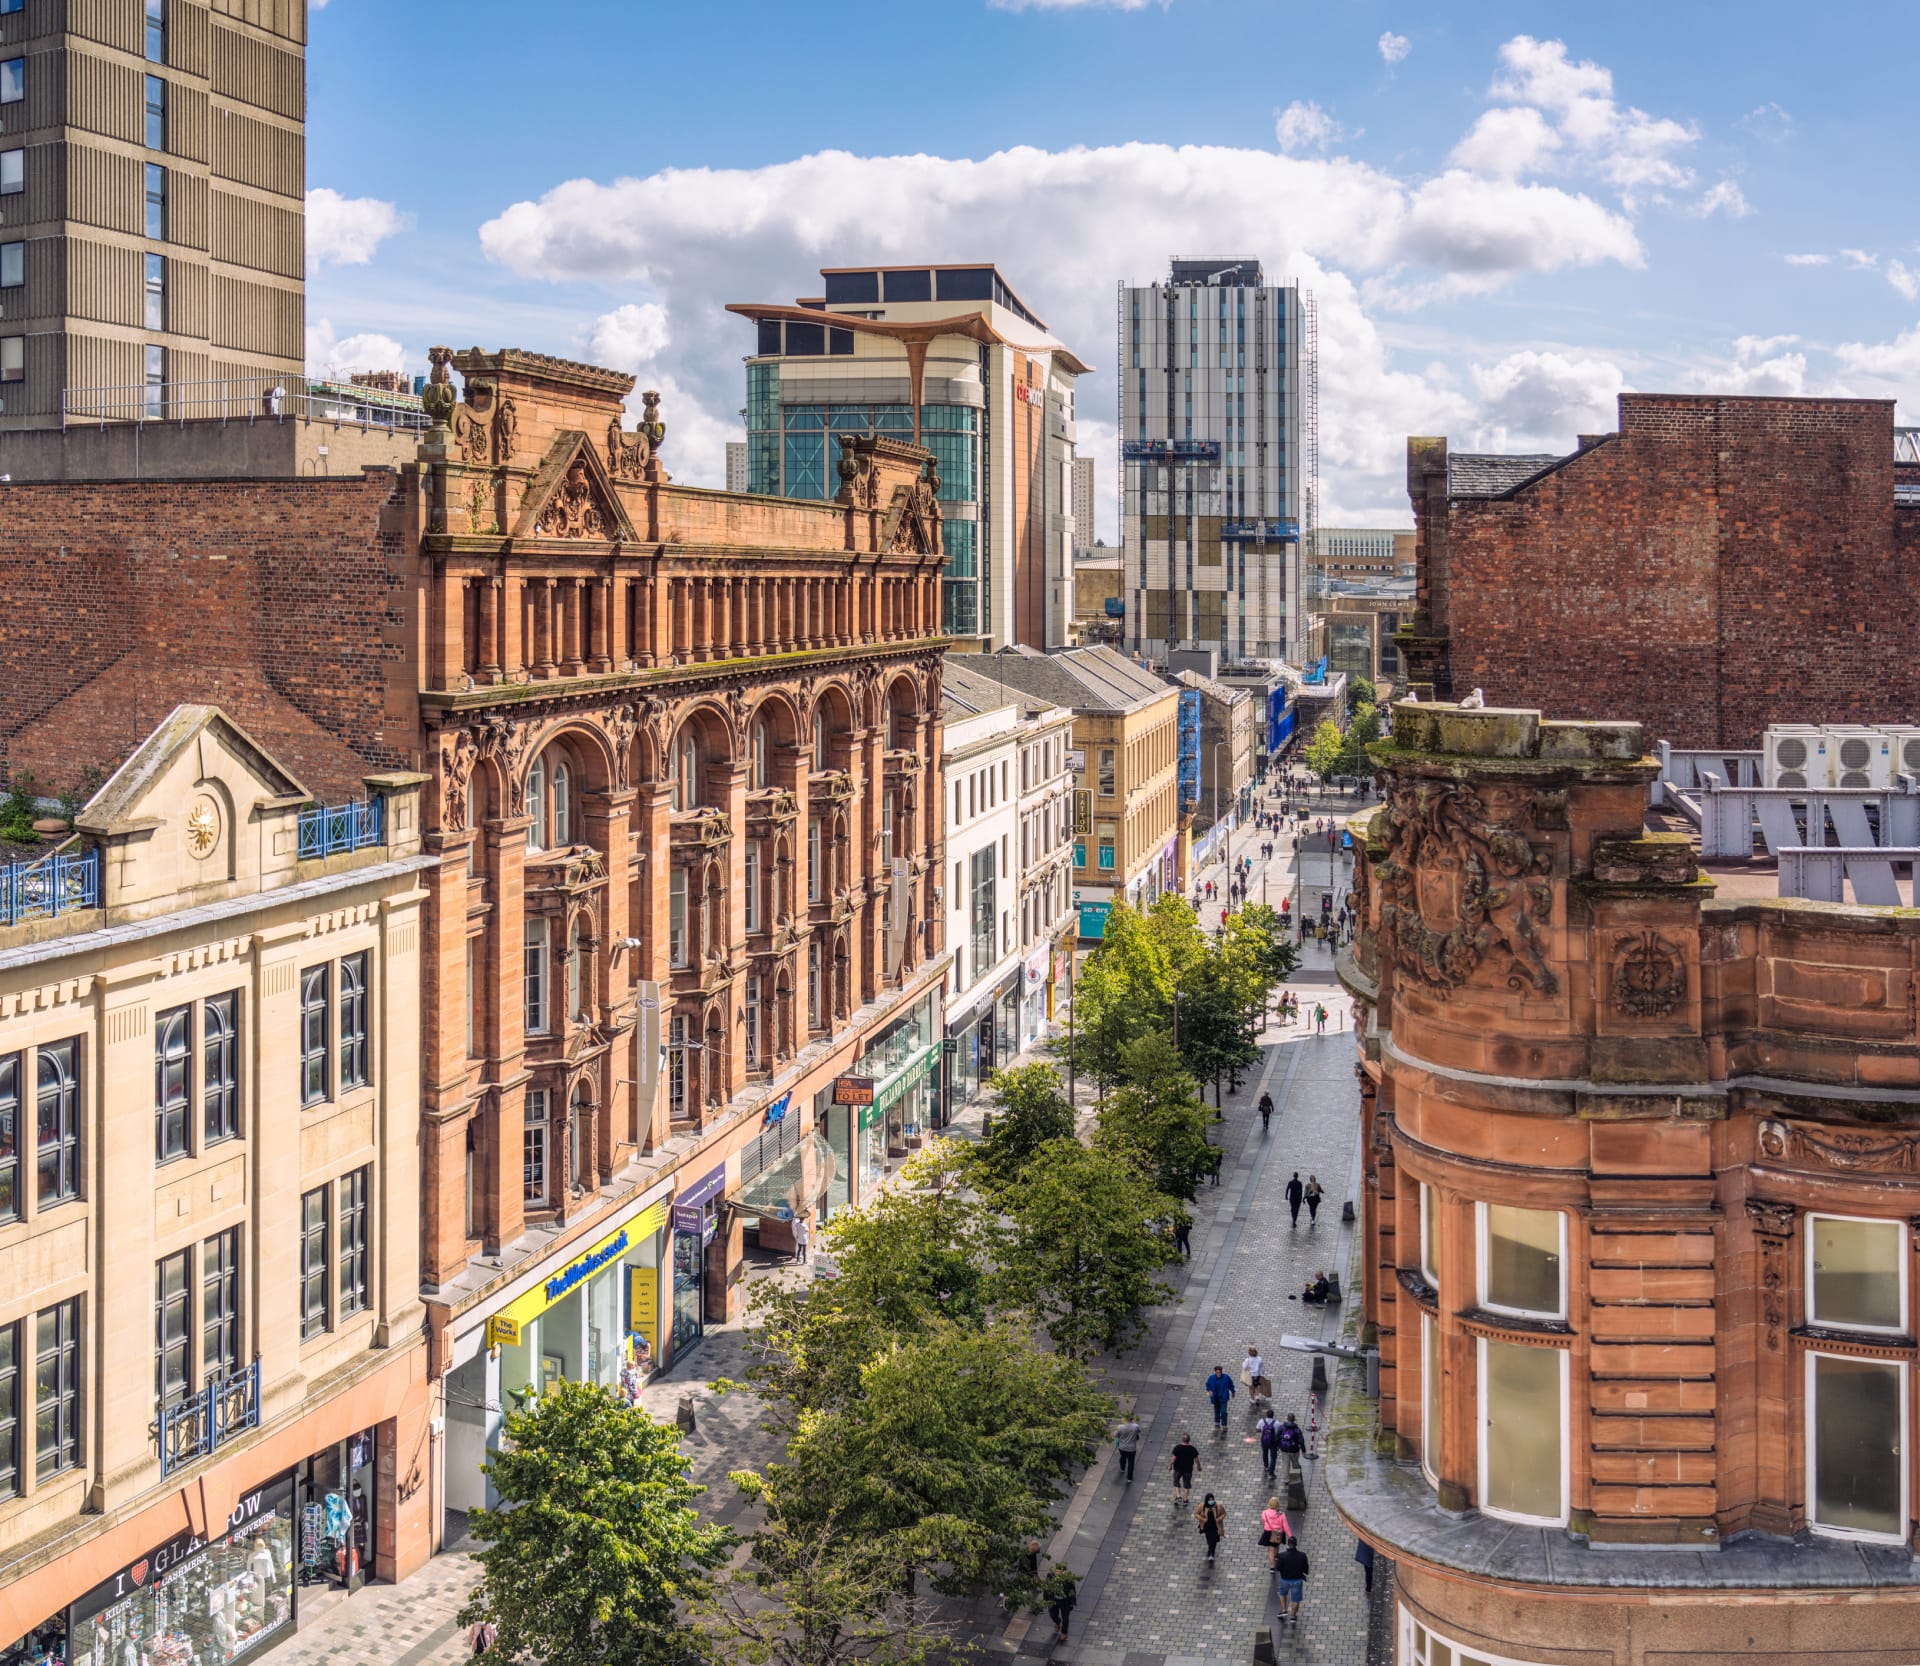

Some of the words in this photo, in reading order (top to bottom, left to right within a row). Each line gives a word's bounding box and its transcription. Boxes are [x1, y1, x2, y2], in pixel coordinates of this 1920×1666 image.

[852, 1093, 870, 1101] LET
[495, 1326, 517, 1336] Works
[500, 1319, 512, 1328] The
[233, 1508, 276, 1543] SOUVENIRS
[161, 1552, 208, 1587] CASHMERE
[105, 1598, 133, 1622] KILTS
[234, 1616, 284, 1655] SHORTBREAD
